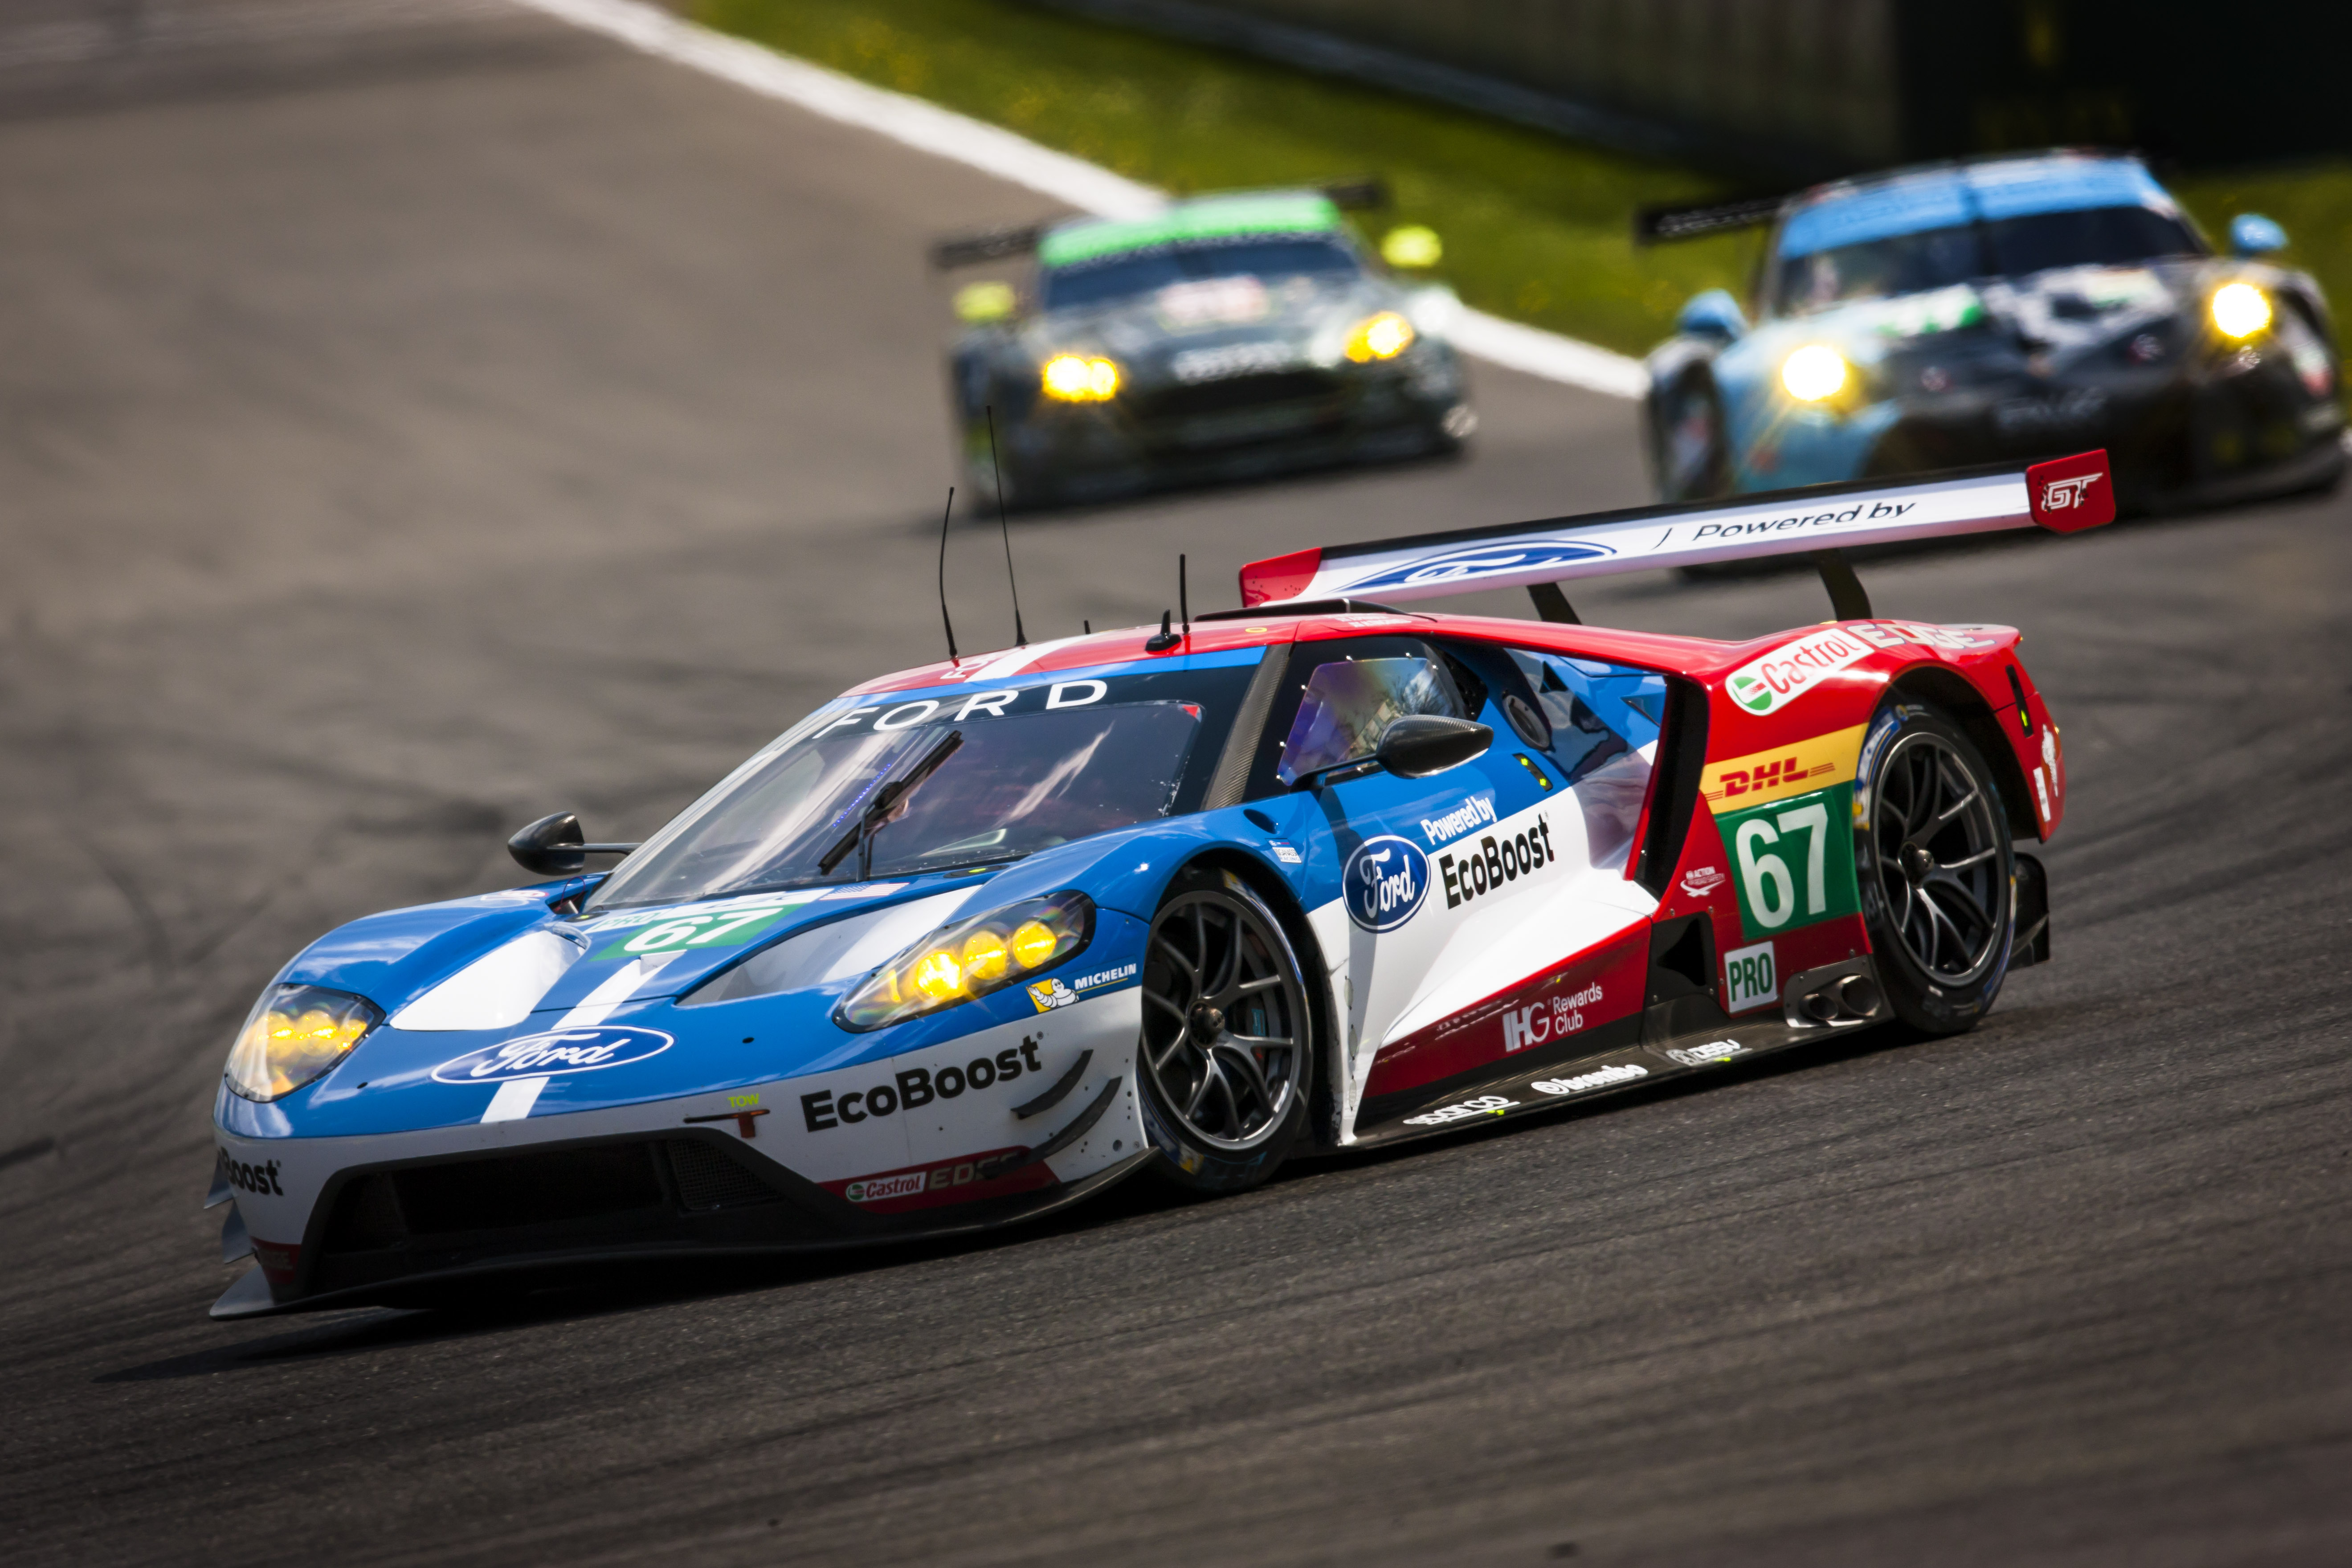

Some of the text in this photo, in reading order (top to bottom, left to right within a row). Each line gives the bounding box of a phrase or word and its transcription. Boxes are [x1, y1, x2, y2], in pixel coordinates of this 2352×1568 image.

[2041, 472, 2103, 510] GT
[1691, 502, 1917, 541] Powered by
[1761, 624, 1997, 694] Castrol EDGE
[812, 680, 1107, 739] FORD
[1720, 757, 1808, 797] DHL
[1420, 796, 1498, 845] Powered by
[1359, 848, 1415, 919] Ford
[1736, 803, 1829, 928] 67
[592, 912, 662, 930] PRO
[624, 908, 784, 952] 67
[1074, 963, 1136, 990] MICHELIN
[1728, 952, 1773, 1003] PRO
[1553, 981, 1603, 1015] Rewards
[1503, 1002, 1550, 1052] IHG
[1555, 1009, 1583, 1035] Club
[470, 1033, 631, 1077] Ford
[1550, 1064, 1649, 1090] brembo
[727, 1093, 760, 1108] TOW
[866, 1176, 921, 1199] Castrol
